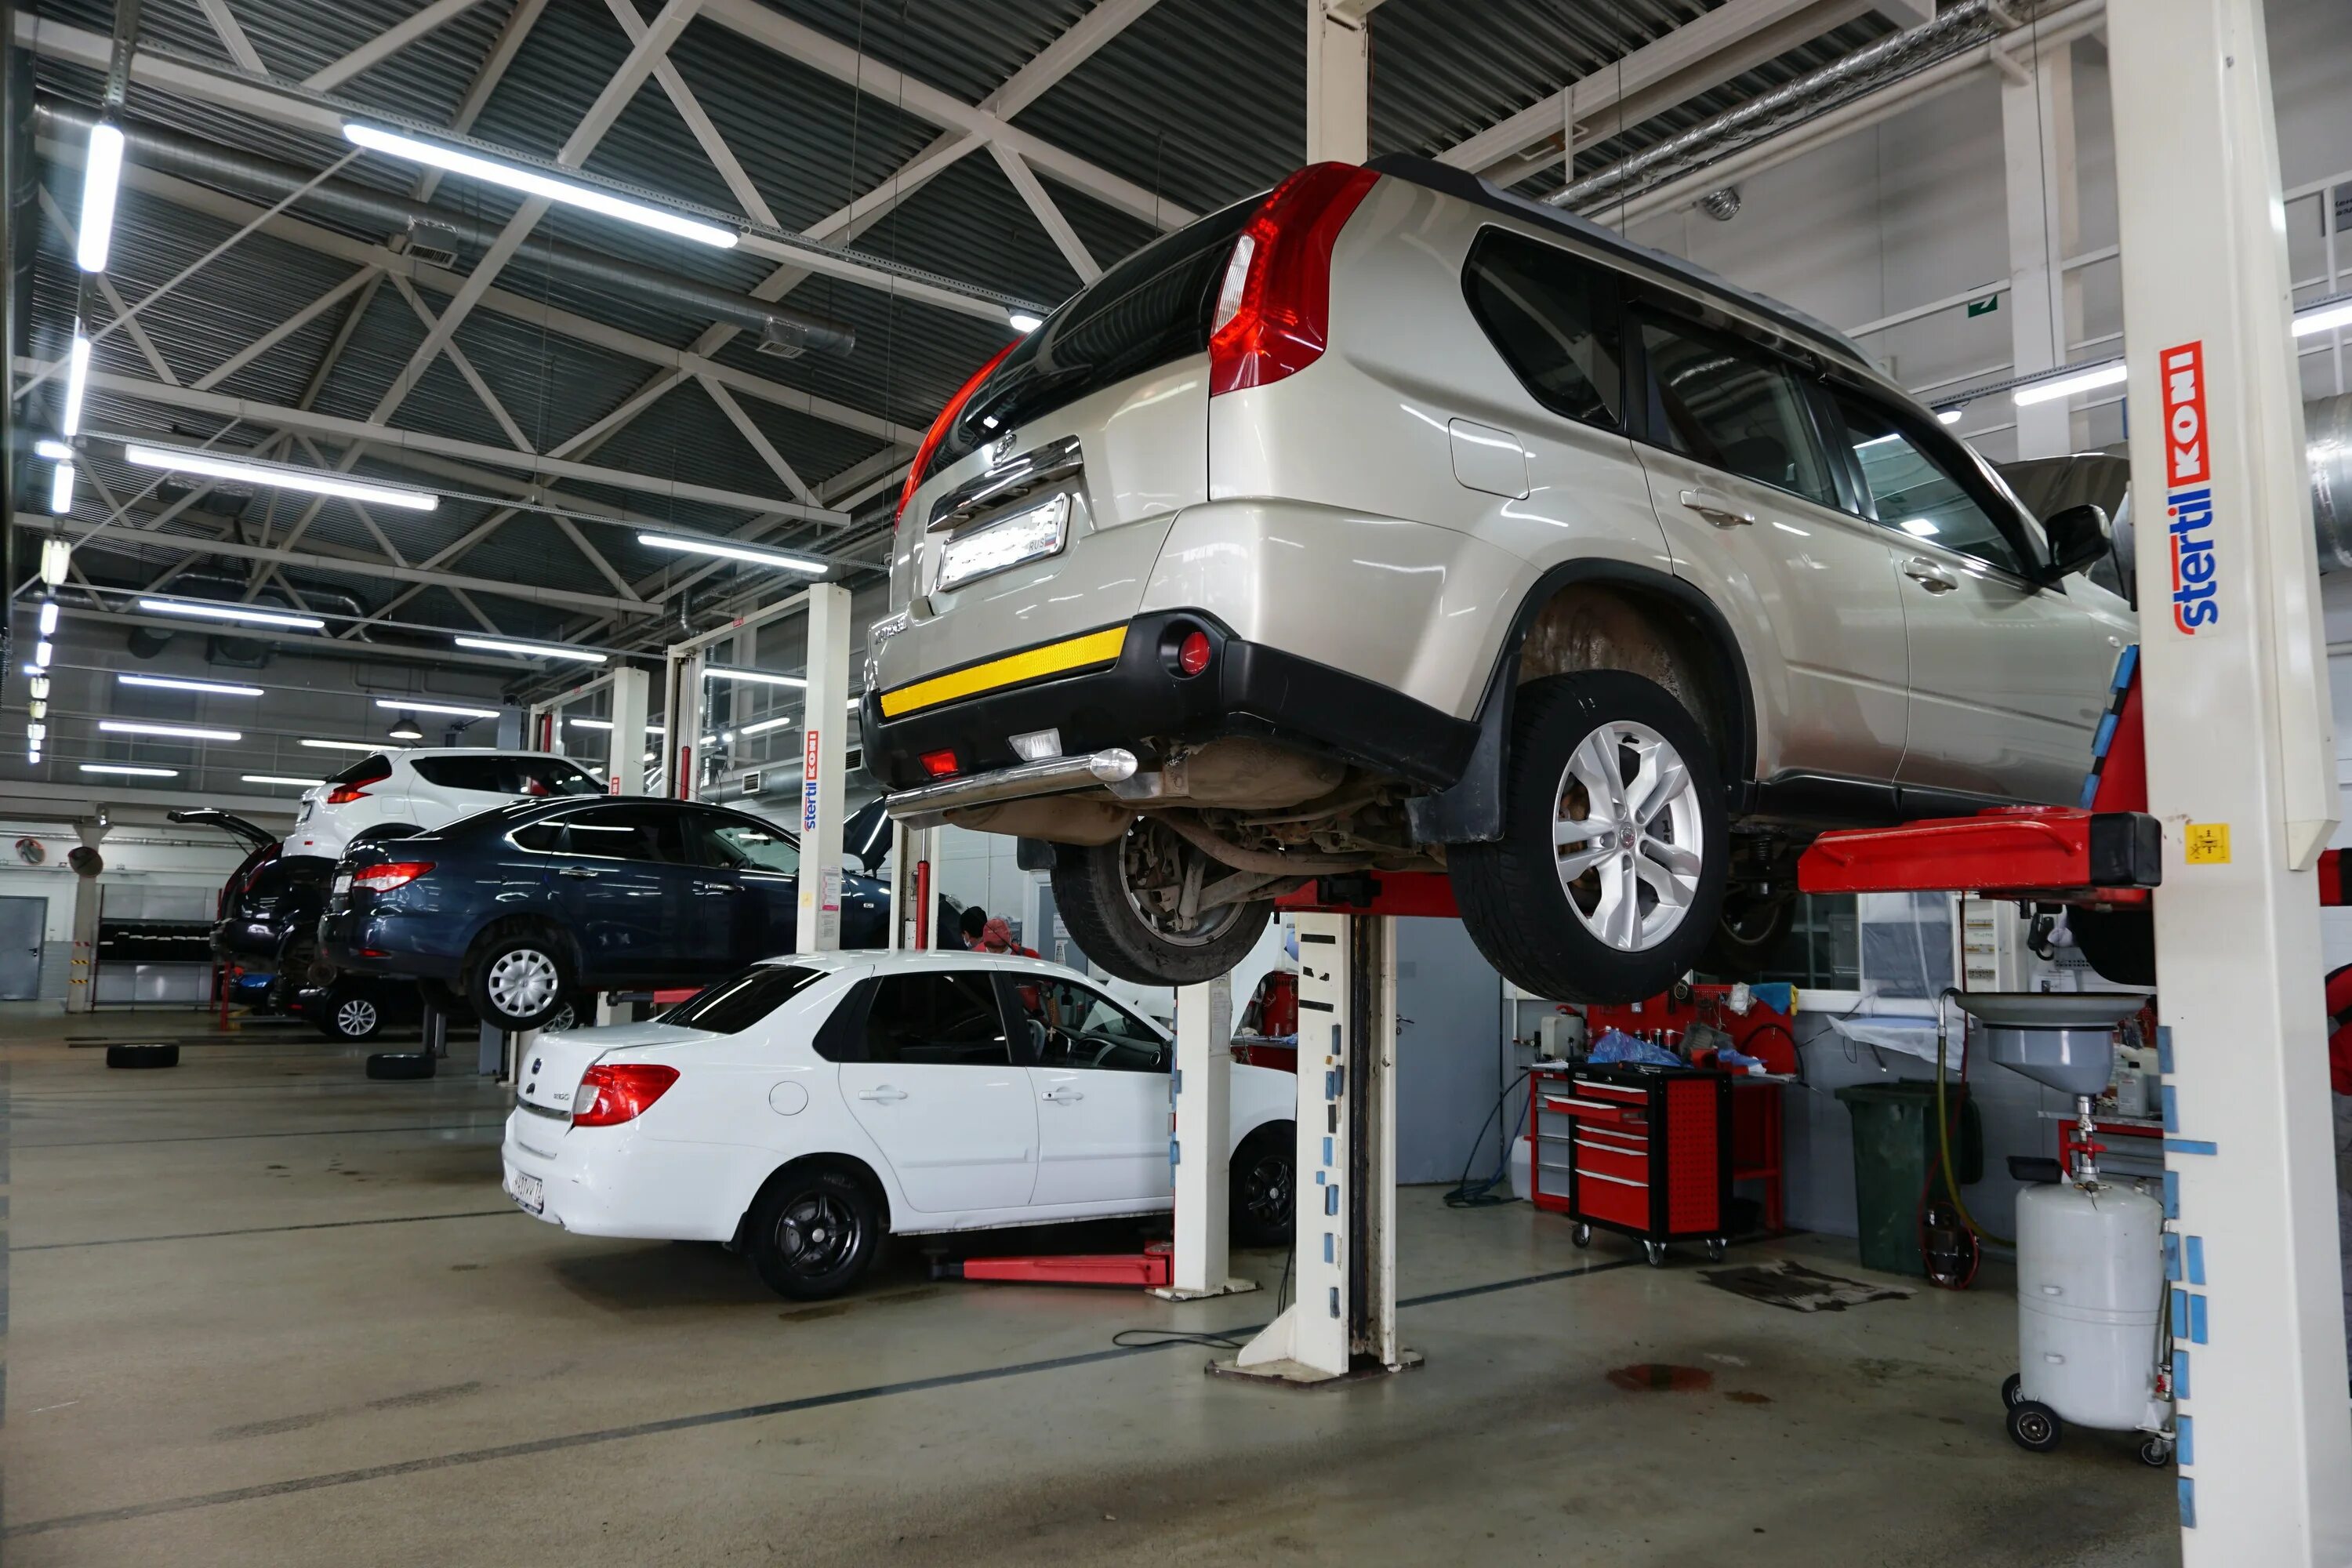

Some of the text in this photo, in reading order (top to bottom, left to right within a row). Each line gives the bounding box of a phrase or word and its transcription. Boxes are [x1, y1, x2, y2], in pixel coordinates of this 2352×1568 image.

[2167, 350, 2218, 628] stertil KONI
[1029, 537, 1045, 552] RUS
[804, 731, 818, 830] stertil KONI
